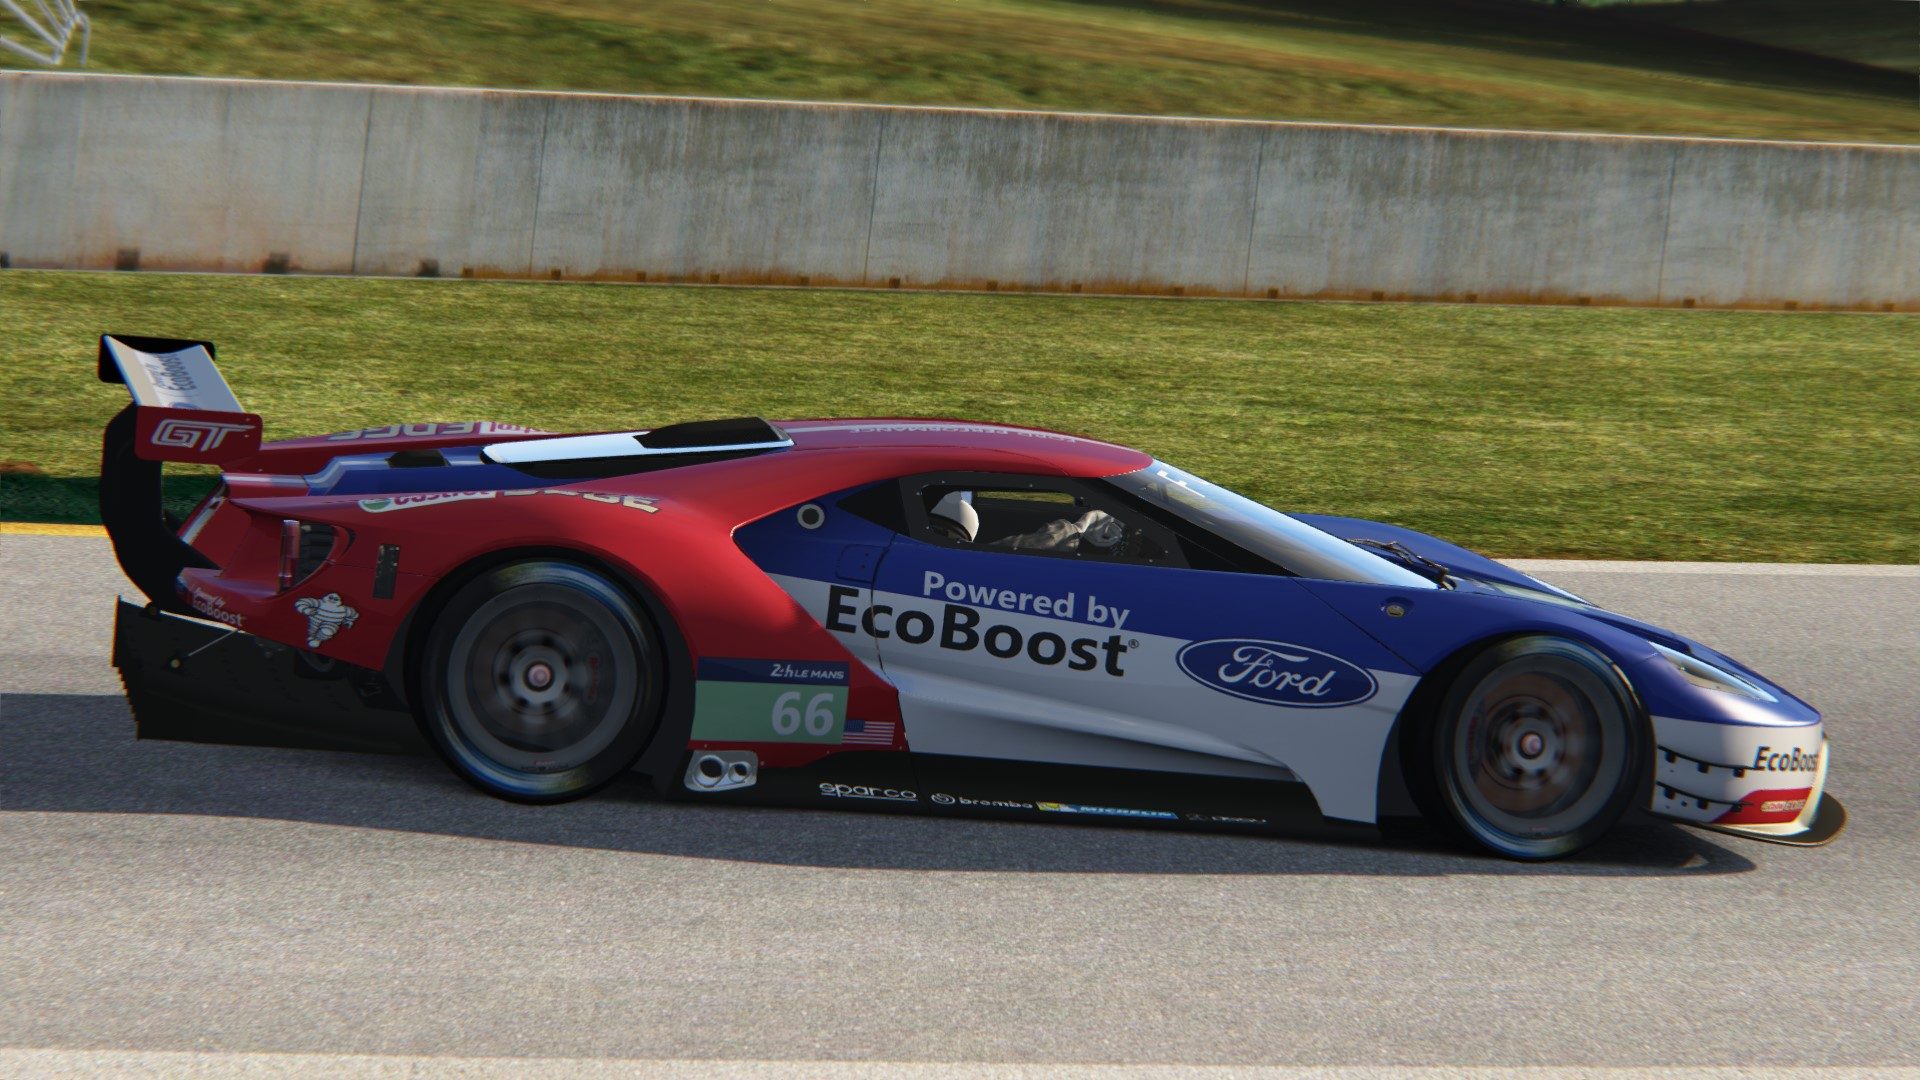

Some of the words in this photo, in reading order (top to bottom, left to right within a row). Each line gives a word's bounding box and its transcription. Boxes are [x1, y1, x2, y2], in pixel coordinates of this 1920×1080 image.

[151, 418, 256, 452] GT
[922, 569, 1076, 619] Powered
[1087, 596, 1130, 629] by
[795, 669, 810, 678] LE
[811, 670, 845, 680] MANS
[1217, 645, 1337, 697] Ford
[771, 690, 835, 737] 66
[818, 782, 918, 799] sparco
[958, 796, 1034, 809] brembo
